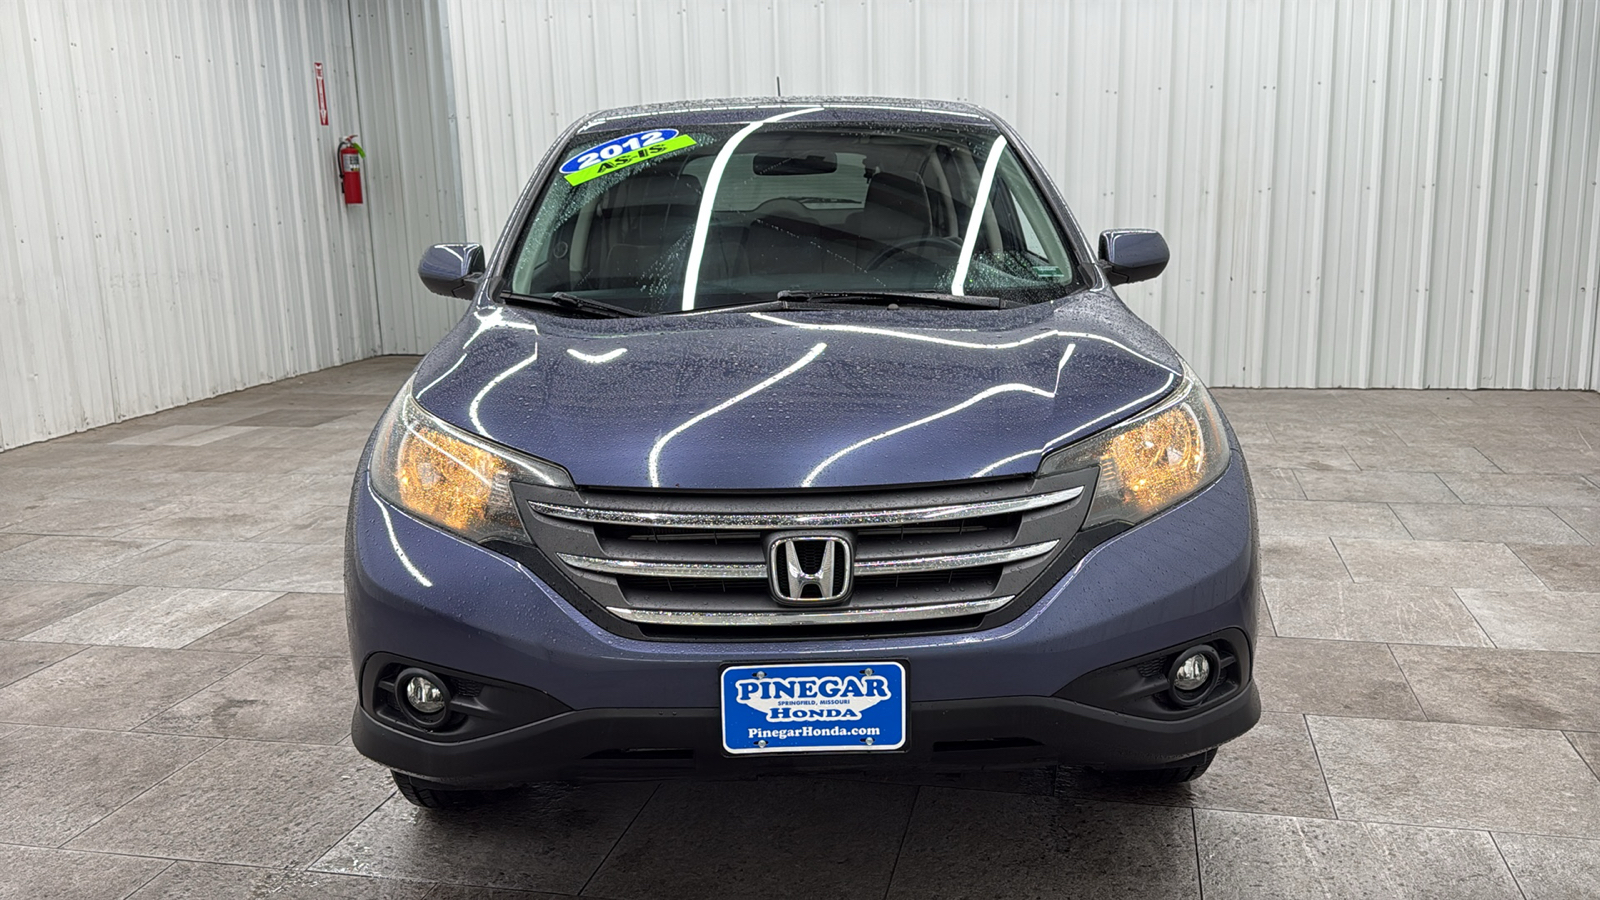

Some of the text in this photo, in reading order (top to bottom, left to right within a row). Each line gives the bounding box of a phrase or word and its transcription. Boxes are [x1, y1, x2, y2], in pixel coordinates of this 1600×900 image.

[577, 131, 665, 170] 2012
[597, 143, 668, 174] AS-IS
[739, 677, 889, 701] PINEGAR
[769, 707, 859, 719] HONDA
[748, 726, 881, 739] PinegarHonda.com
